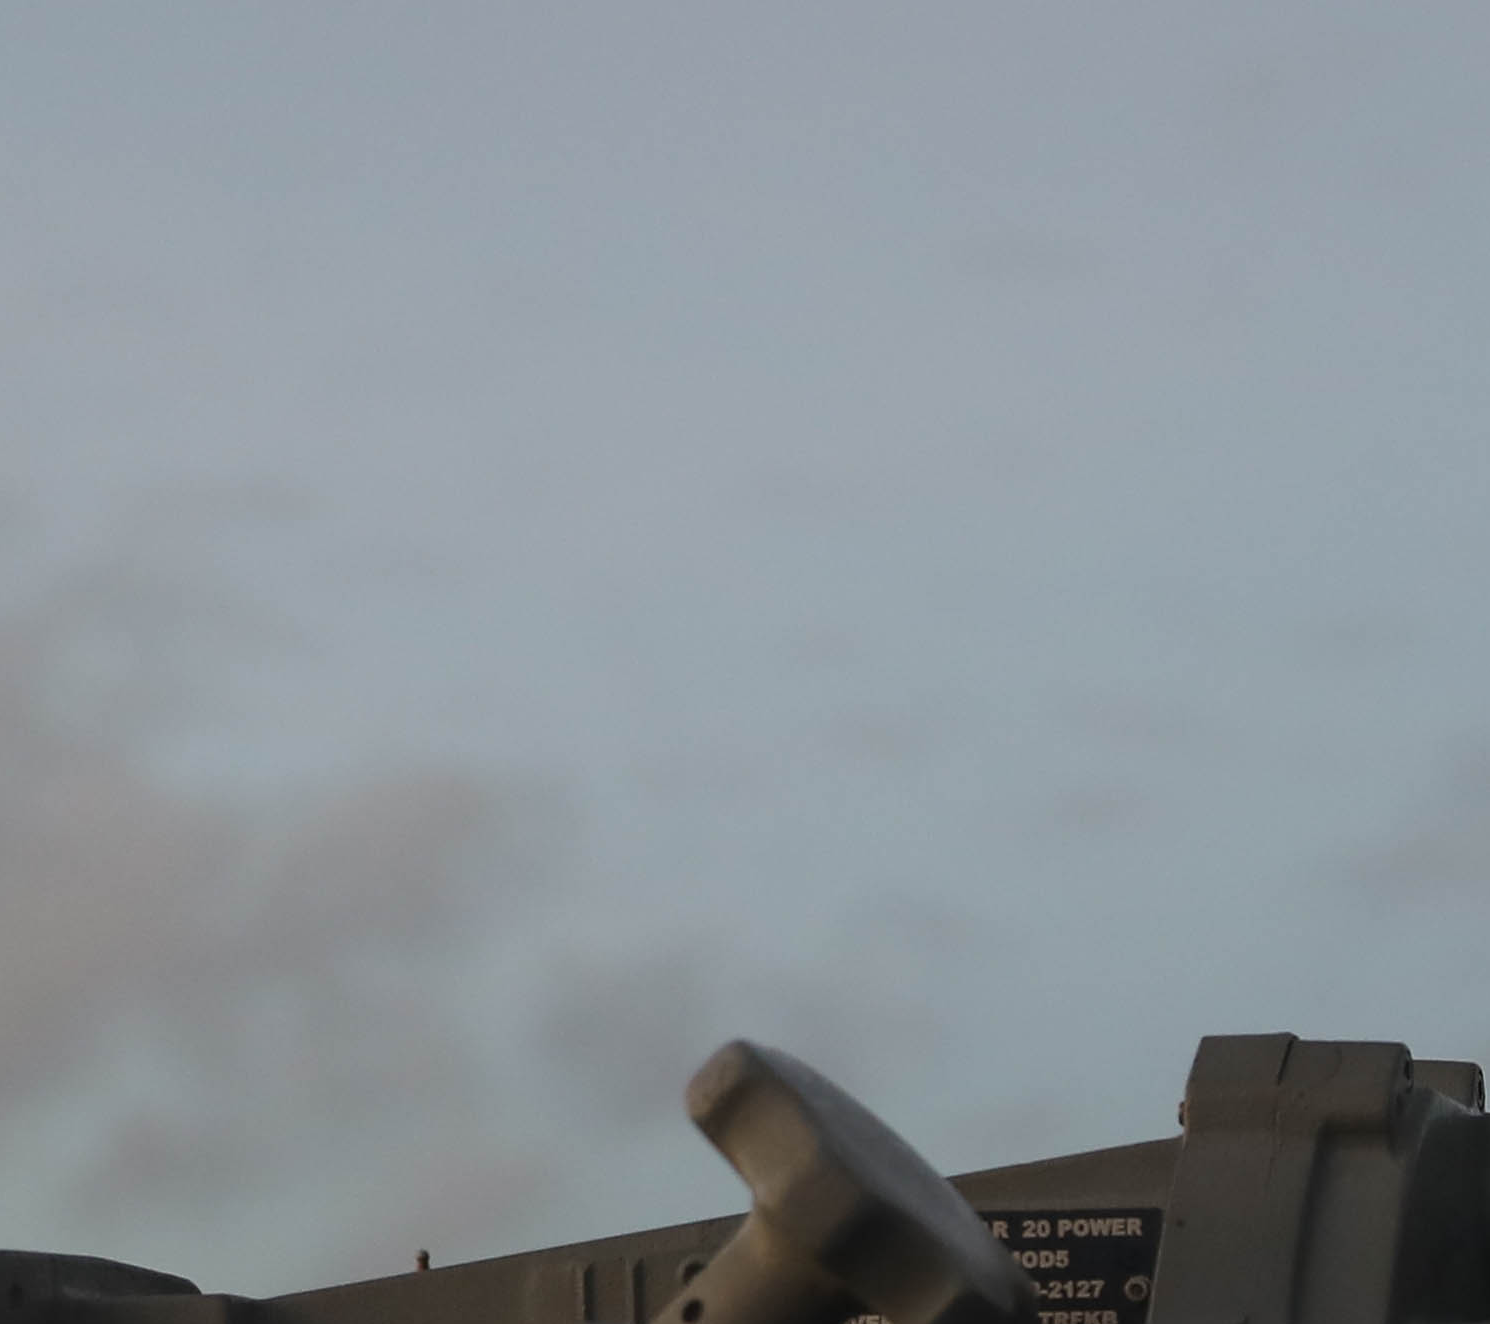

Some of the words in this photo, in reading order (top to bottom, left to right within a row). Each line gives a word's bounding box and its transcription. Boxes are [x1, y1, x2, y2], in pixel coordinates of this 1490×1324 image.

[1021, 1219, 1051, 1238] 20
[1057, 1217, 1143, 1239] POWER
[1012, 1249, 1070, 1269] OD5
